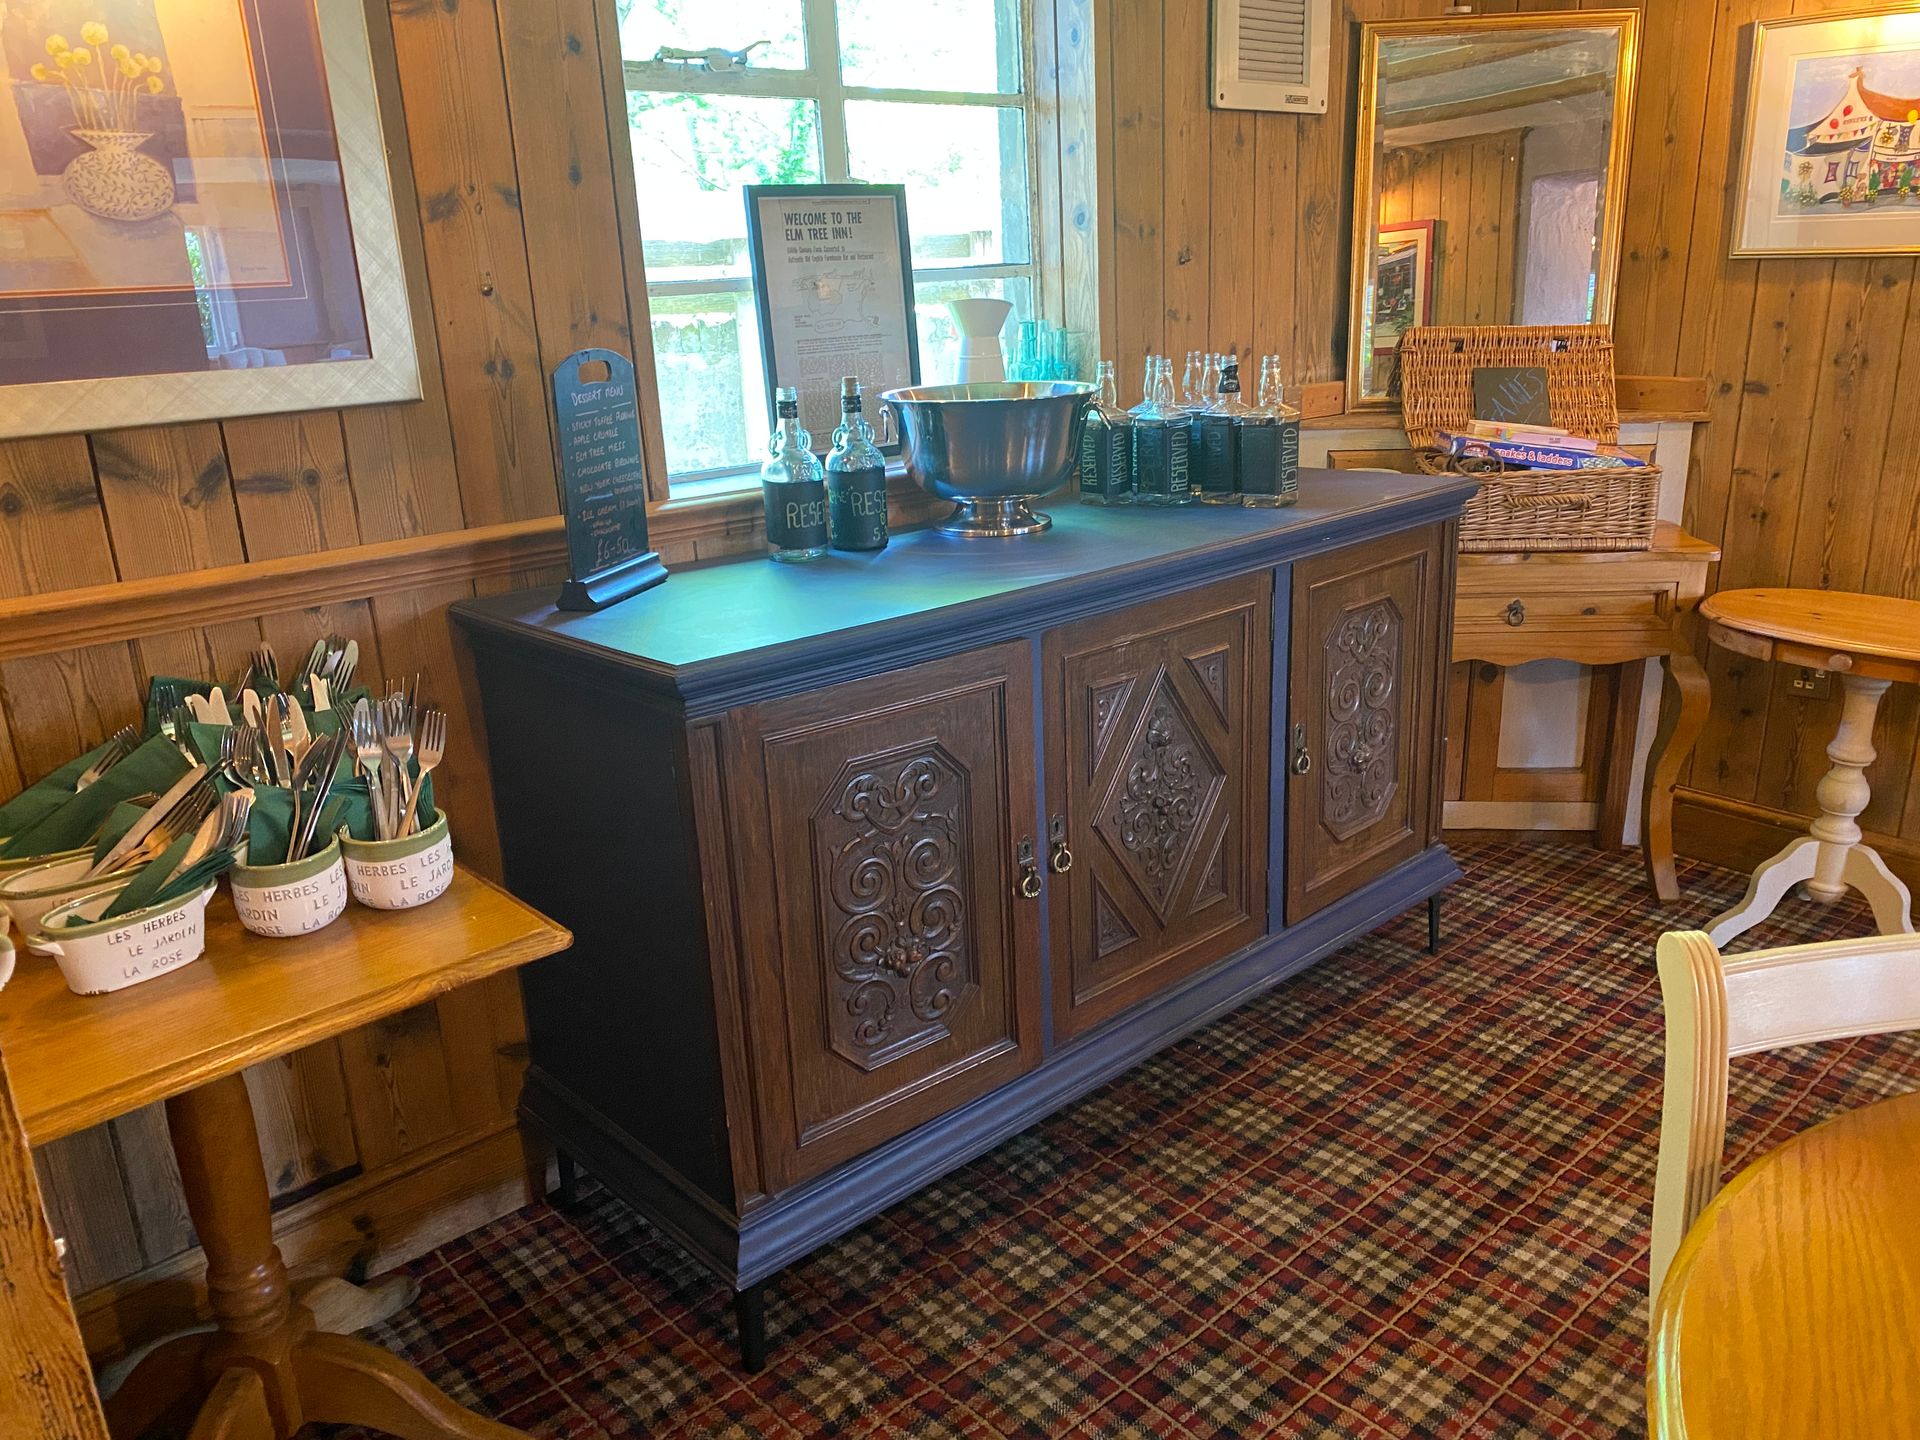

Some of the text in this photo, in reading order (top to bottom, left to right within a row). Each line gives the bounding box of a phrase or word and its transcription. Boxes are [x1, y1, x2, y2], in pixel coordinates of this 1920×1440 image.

[784, 211, 862, 226] WELCOME TO THE
[785, 226, 853, 241] ELM TREE INN!
[571, 384, 624, 406] DESSERT MENU
[571, 420, 591, 432] STICKY
[594, 413, 614, 426] TOFFEE
[593, 427, 619, 441] CRUMBLE
[575, 440, 626, 462] ELM TREE MESS
[1082, 435, 1097, 485] RESERVED
[1111, 433, 1127, 485] RESERVED
[1171, 431, 1188, 492] RESERVED
[1281, 428, 1297, 493] RESERVED
[1537, 451, 1573, 466] ladders
[786, 500, 825, 529] RESE
[357, 850, 441, 877] HERBES LES
[263, 881, 319, 902] HERBES
[329, 865, 343, 884] LES
[400, 876, 418, 890] LE
[313, 894, 329, 910] LE
[390, 897, 409, 908] LA
[107, 910, 186, 946] LES HERBES
[302, 918, 320, 931] LA
[128, 923, 196, 957] LE JARDIN
[123, 949, 183, 979] LA ROSE
